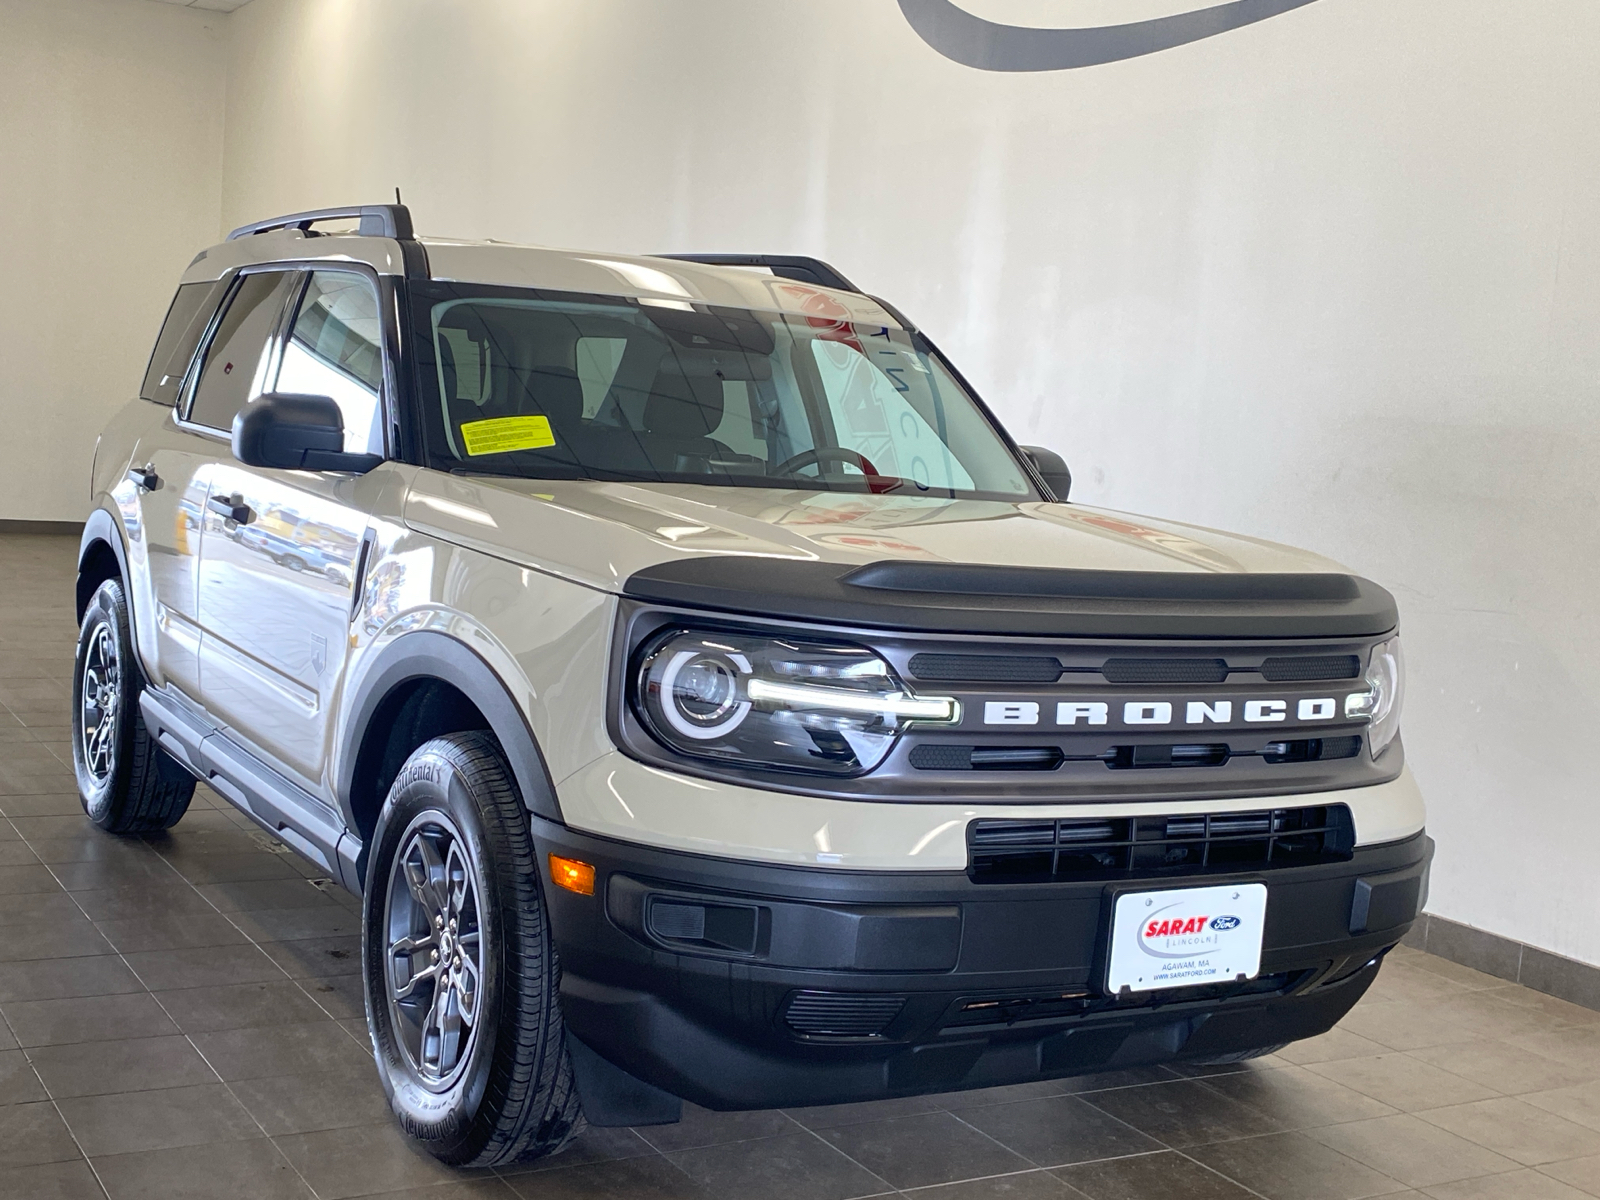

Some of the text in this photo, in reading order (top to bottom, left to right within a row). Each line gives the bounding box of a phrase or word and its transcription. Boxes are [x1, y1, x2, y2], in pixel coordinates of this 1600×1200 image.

[983, 698, 1336, 725] BRONCO
[1144, 916, 1238, 938] SARAT Ford
[1172, 936, 1211, 946] LINCOLN
[1162, 959, 1210, 971] AGAWAM, MA
[1153, 968, 1217, 981] WWW.SARATFORD.COM
